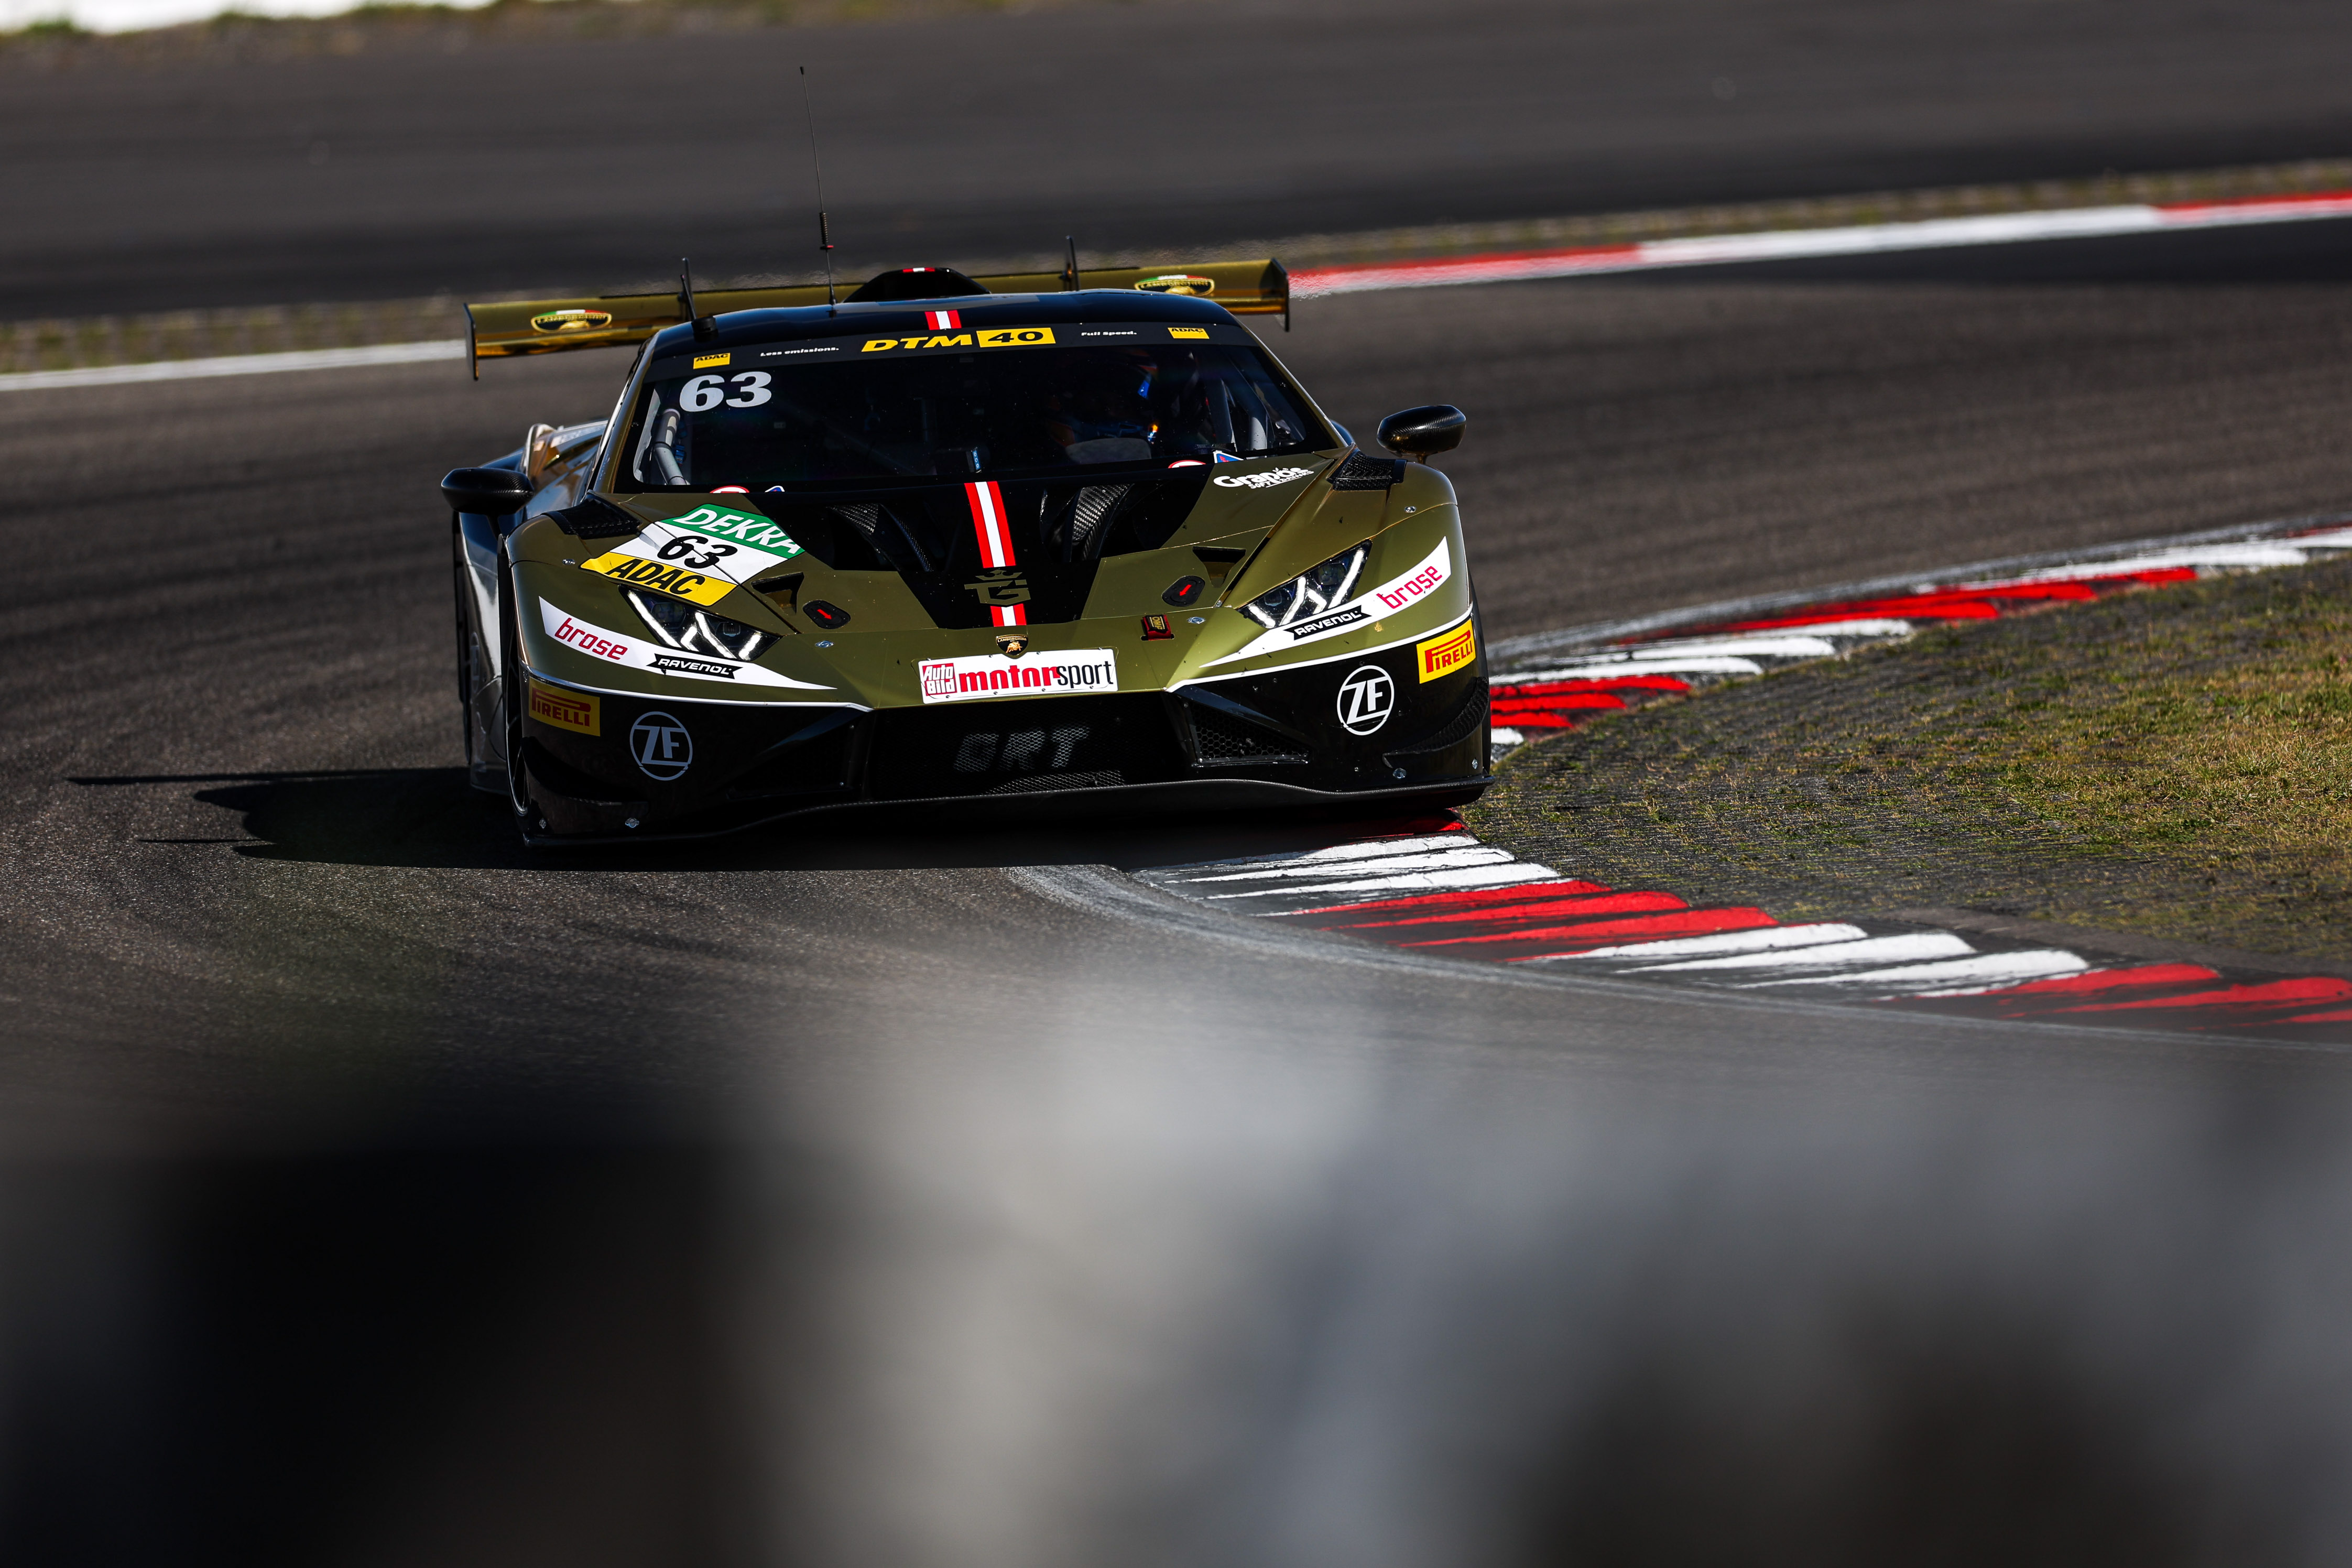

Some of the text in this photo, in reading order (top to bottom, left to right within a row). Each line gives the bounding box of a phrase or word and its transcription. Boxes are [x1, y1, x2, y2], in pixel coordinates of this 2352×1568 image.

[695, 353, 728, 362] ADAC
[861, 331, 1044, 352] DTM 40
[680, 371, 772, 412] 63
[1248, 481, 1272, 489] SOFT
[673, 508, 801, 554] DEKRA
[657, 535, 738, 569] 63
[604, 558, 706, 595] ADAC
[1376, 565, 1443, 609] brose
[554, 617, 628, 660] brose
[1293, 610, 1362, 636] RAVENOL
[658, 658, 731, 675] RAVENOL
[1424, 629, 1473, 674] PIRELLI
[923, 665, 954, 681] Auto
[926, 678, 956, 694] Bild
[531, 687, 591, 727] PIRELLI
[1342, 675, 1390, 724] ZF
[633, 725, 689, 768] ZF
